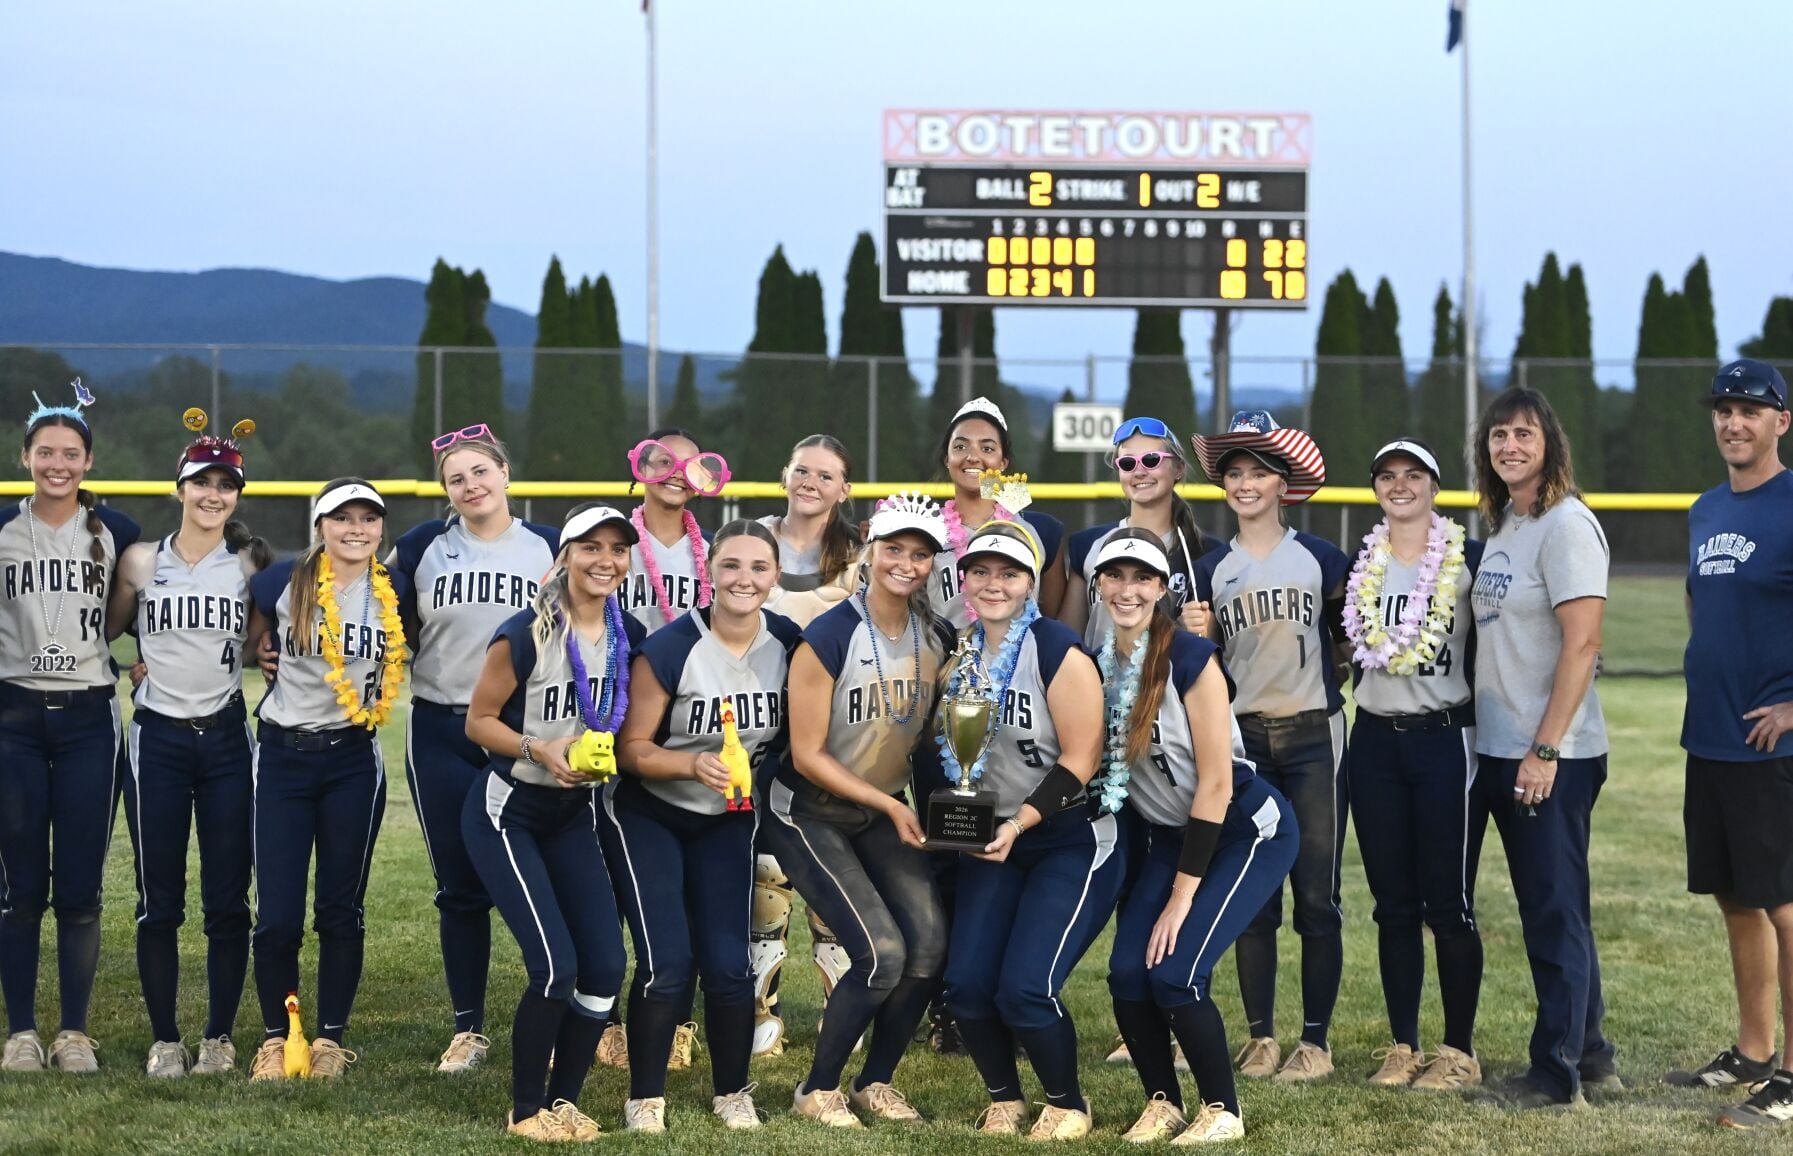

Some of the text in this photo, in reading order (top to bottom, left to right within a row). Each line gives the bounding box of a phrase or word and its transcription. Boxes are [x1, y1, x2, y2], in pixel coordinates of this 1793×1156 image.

[917, 114, 1280, 157] BOTETOURT
[893, 168, 920, 187] AT
[975, 178, 1026, 200] BALL
[1029, 171, 1053, 207] 2
[1056, 178, 1127, 201] STRIKE
[1139, 172, 1151, 208] 1
[1154, 179, 1195, 202] OUT
[1197, 173, 1220, 208] 2
[886, 187, 926, 208] BAT
[992, 218, 1003, 236] 1
[1013, 218, 1027, 236] 2
[1035, 218, 1049, 236] 3
[1056, 218, 1071, 236] 4
[1079, 218, 1093, 237] 5
[1100, 219, 1114, 238] 6
[1123, 219, 1136, 238] 7
[1144, 219, 1159, 238] 8
[1166, 219, 1180, 238] 9
[1185, 219, 1207, 239] 10
[896, 238, 985, 262] VISITOR
[907, 269, 971, 294] HOME
[1063, 415, 1115, 440] 300
[1697, 532, 1757, 566] RAIDERS
[5, 557, 107, 601] RAIDERS
[1699, 559, 1736, 576] SOFTBALL
[432, 570, 540, 611] RAIDERS
[79, 607, 103, 642] 19
[146, 593, 245, 636] RAIDERS
[1218, 586, 1313, 642] RAIDERS
[31, 653, 77, 674] 2022
[220, 640, 236, 675] 4
[1296, 634, 1306, 669] 1
[1016, 738, 1044, 768] 5
[944, 813, 968, 821] REGION
[942, 829, 977, 837] CHAMPION
